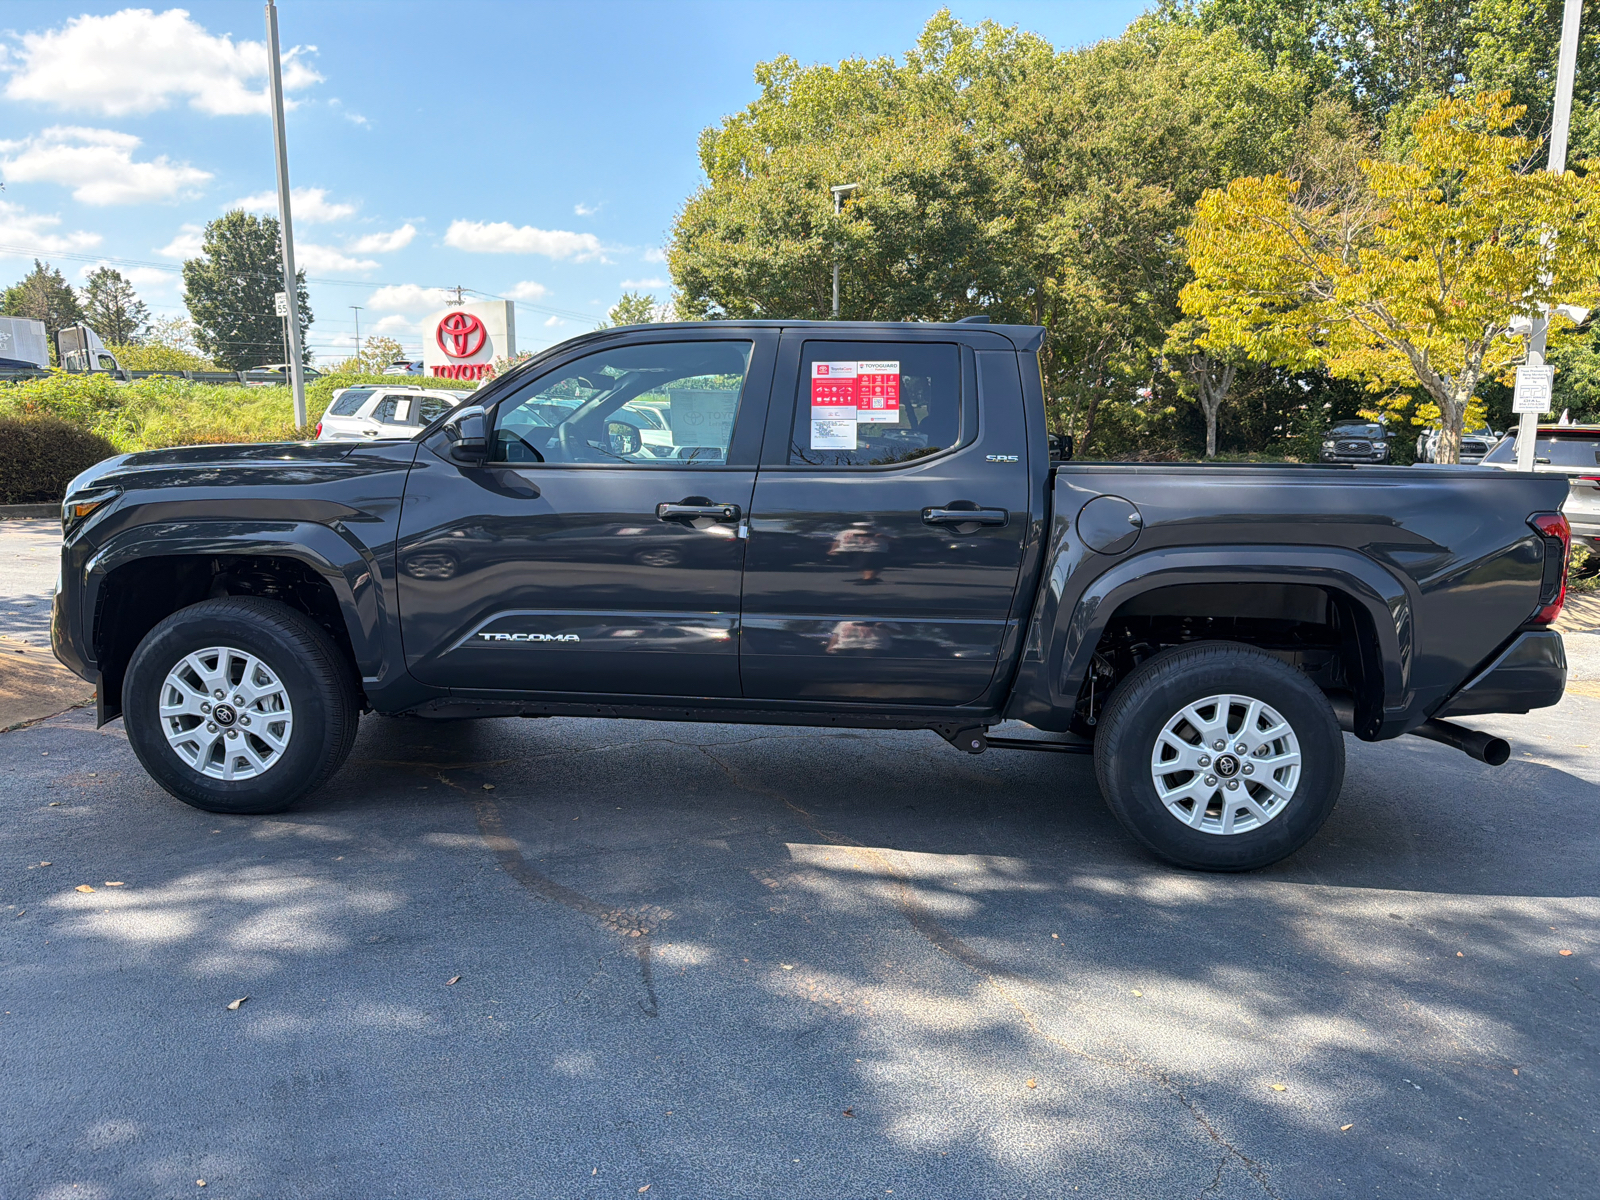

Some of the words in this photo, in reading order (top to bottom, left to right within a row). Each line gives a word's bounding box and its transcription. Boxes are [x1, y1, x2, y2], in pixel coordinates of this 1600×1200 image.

[278, 305, 287, 313] 55
[707, 411, 733, 420] TOYO
[986, 454, 1019, 463] SR5
[478, 633, 580, 642] TACOMA
